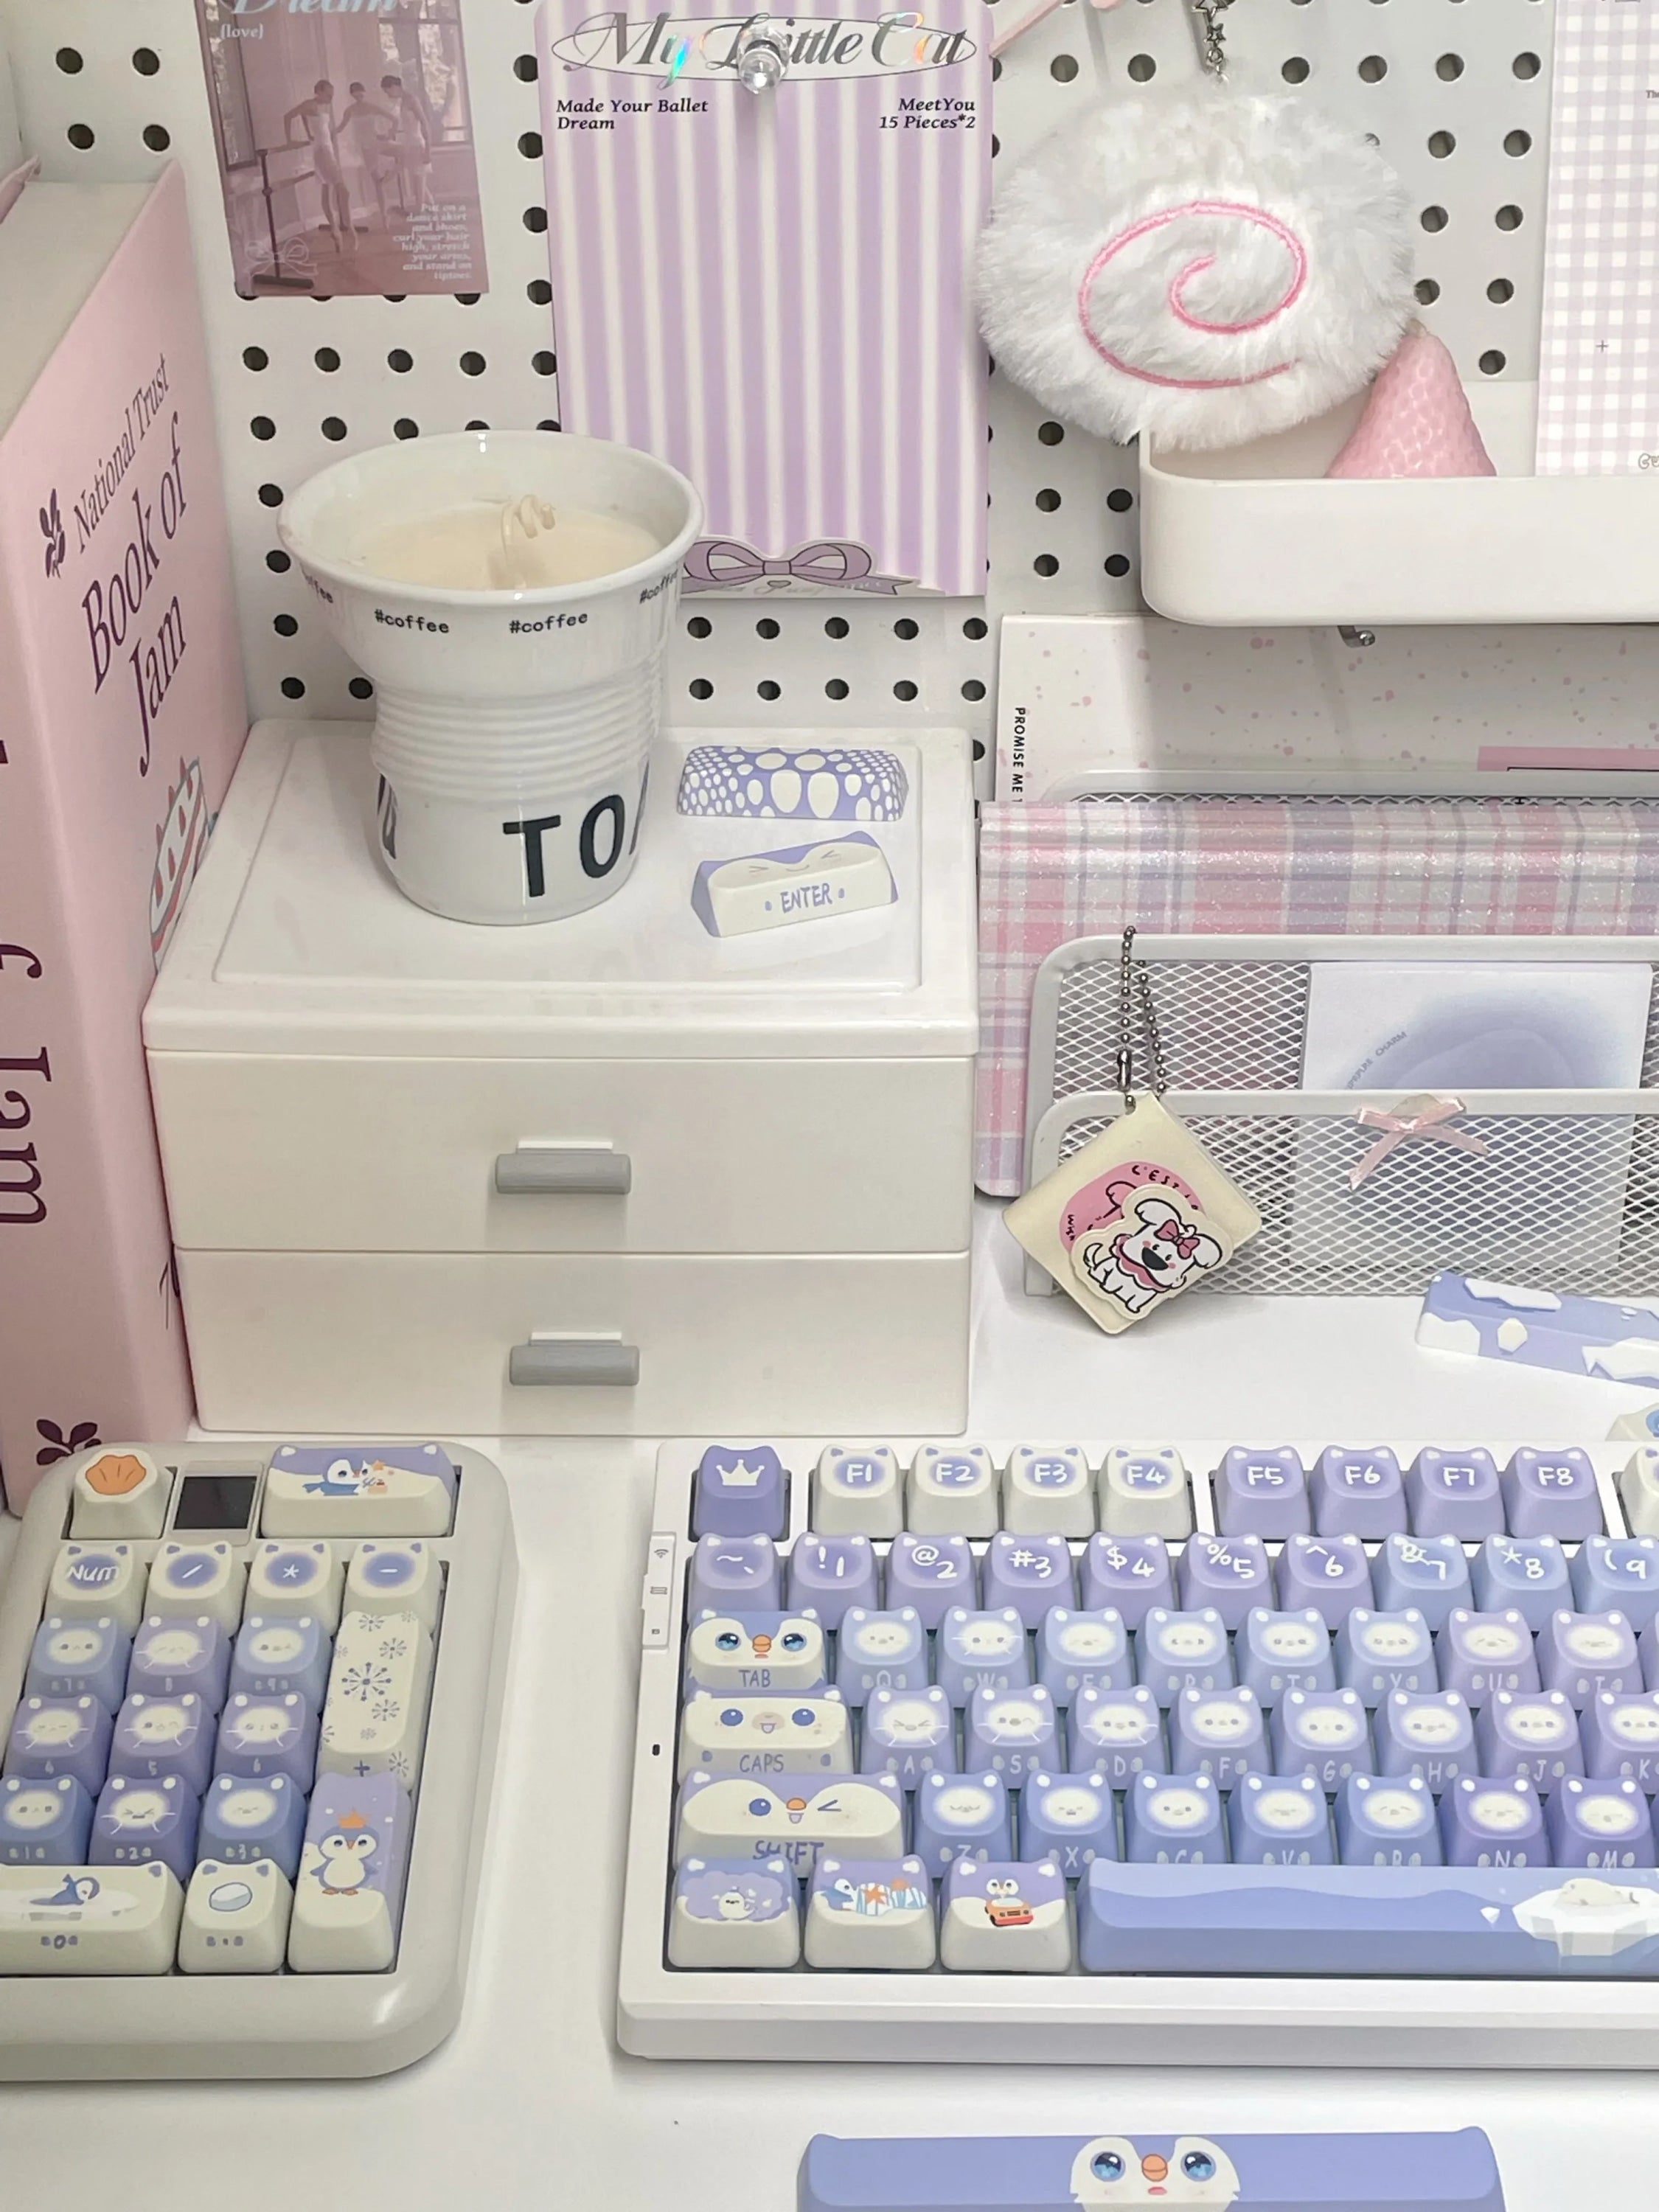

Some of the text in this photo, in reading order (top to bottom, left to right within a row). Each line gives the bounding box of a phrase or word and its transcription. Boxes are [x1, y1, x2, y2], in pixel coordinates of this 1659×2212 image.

[563, 12, 692, 90] My
[872, 12, 968, 67] Cat
[557, 100, 709, 114] Made Your Ballet
[557, 116, 615, 131] Dream
[880, 116, 899, 129] 15
[74, 352, 170, 554] National Trust
[82, 411, 187, 695] Book of
[375, 609, 450, 634] #coffee
[509, 613, 588, 634] #coffee
[129, 595, 187, 778] Jam
[1013, 707, 1026, 768] PROMISE
[1012, 774, 1023, 793] ME
[780, 883, 832, 914] ENTER
[846, 1464, 872, 1483] F1
[936, 1464, 974, 1482] F2
[1034, 1464, 1068, 1483] F3
[1127, 1465, 1166, 1484] F4
[1247, 1466, 1284, 1486] F5
[1344, 1465, 1380, 1485] F6
[1442, 1467, 1475, 1486] F7
[1537, 1467, 1574, 1486] F8
[66, 1565, 119, 1582] Num
[738, 1669, 771, 1688] TAB
[739, 1754, 785, 1773] CAPS
[904, 1755, 914, 1775] A
[1009, 1755, 1021, 1775] S
[1114, 1756, 1126, 1776] D
[1219, 1757, 1231, 1778] F
[1323, 1760, 1335, 1781] G
[1427, 1761, 1442, 1783] H
[1534, 1759, 1547, 1781] J
[1638, 1759, 1652, 1781] K
[1065, 1846, 1079, 1868] X
[1495, 1850, 1511, 1867] N
[1602, 1850, 1618, 1869] M
